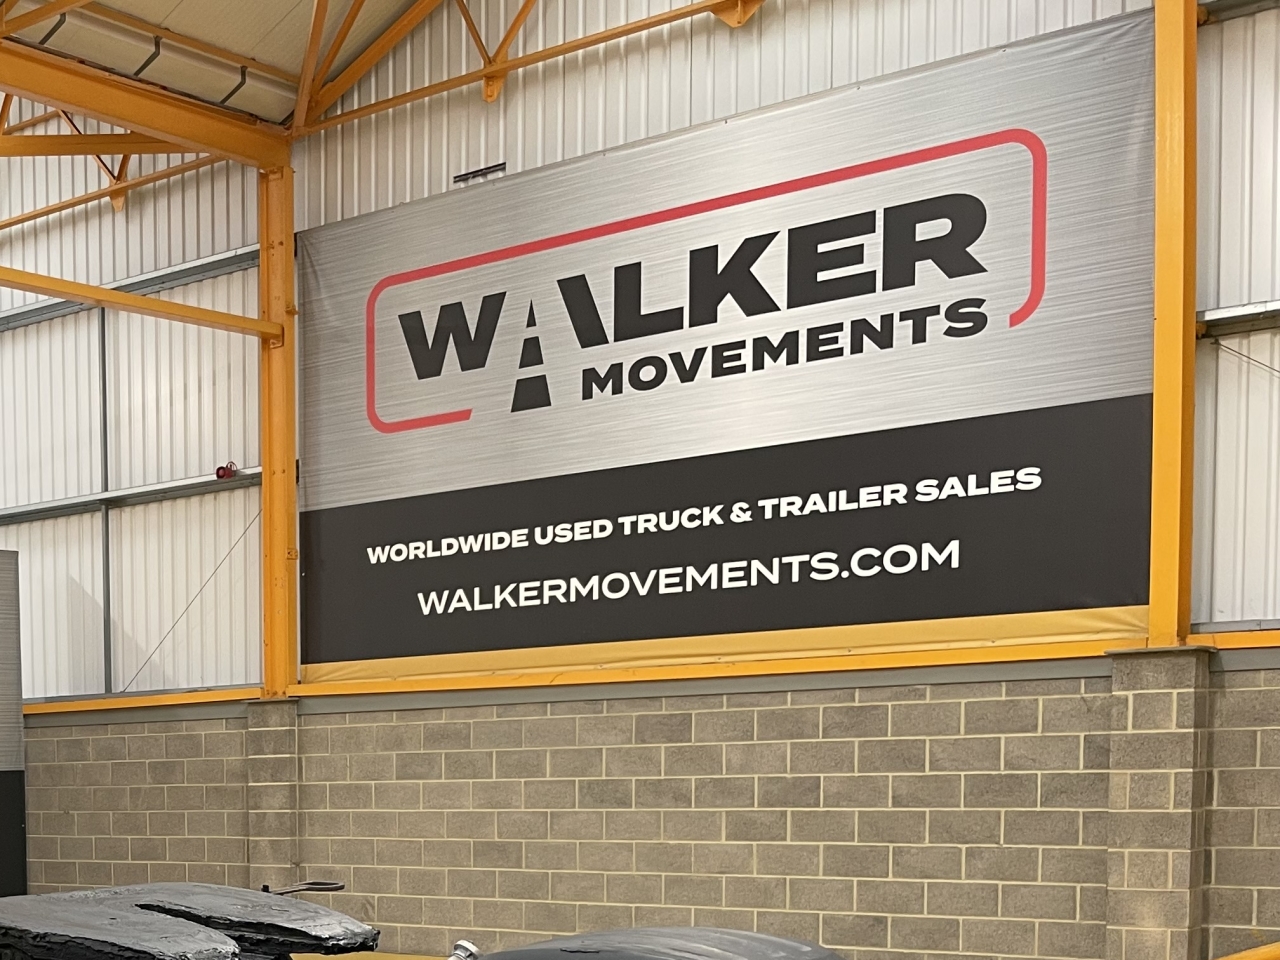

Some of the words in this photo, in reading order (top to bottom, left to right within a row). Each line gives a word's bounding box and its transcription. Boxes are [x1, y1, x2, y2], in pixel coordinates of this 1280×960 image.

[397, 193, 988, 413] WALKER
[581, 297, 988, 400] MOVEMENTS
[366, 528, 529, 565] WORLDWIDE
[534, 518, 614, 546] USED
[617, 504, 724, 536] TRUCK
[730, 501, 753, 523] &
[757, 483, 908, 520] TRAILER
[914, 466, 1042, 502] SALES
[417, 539, 960, 616] WALKERMOVEMENTS.COM
